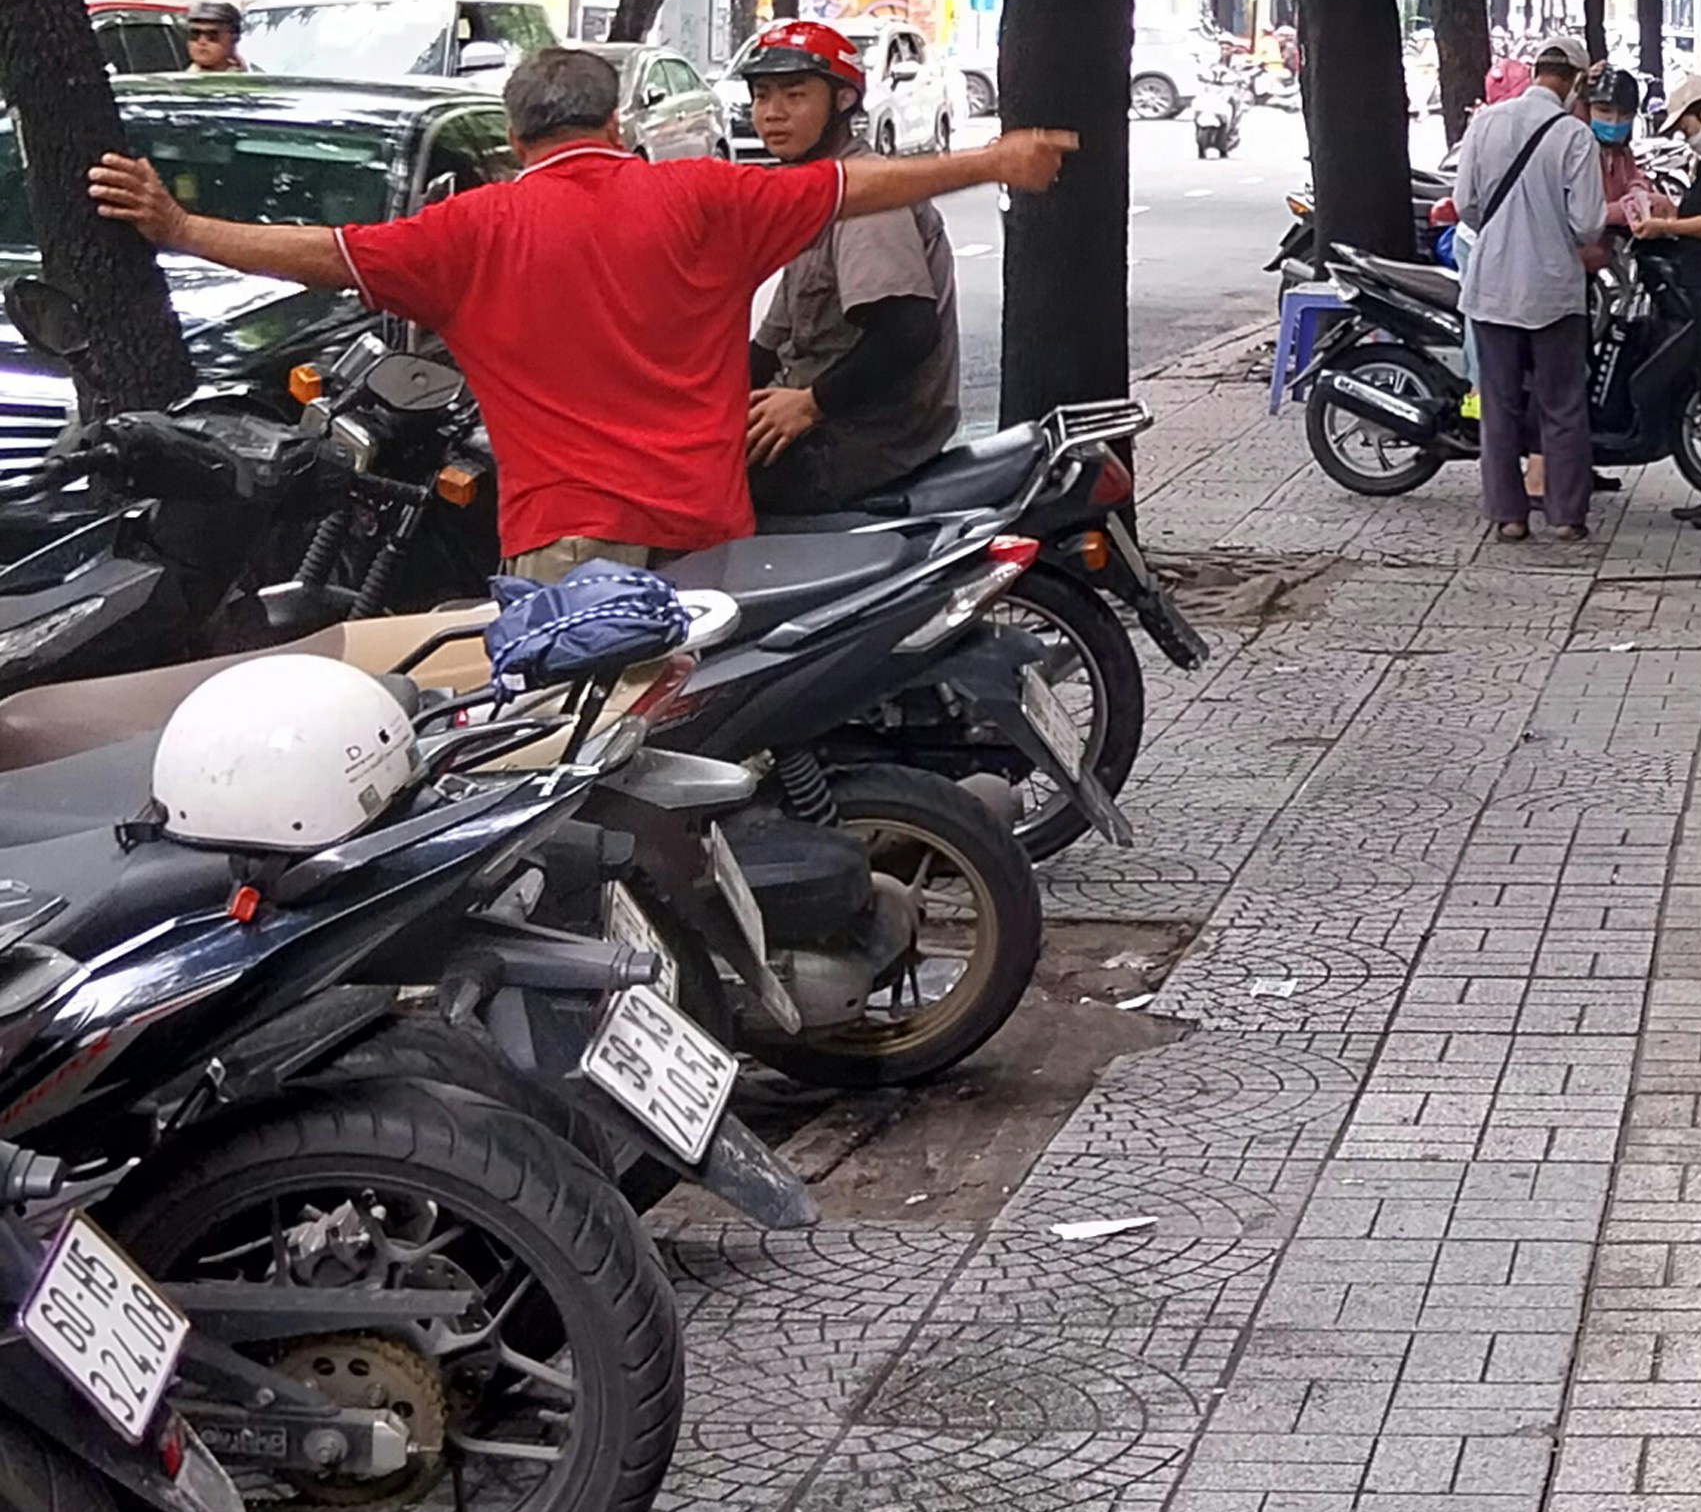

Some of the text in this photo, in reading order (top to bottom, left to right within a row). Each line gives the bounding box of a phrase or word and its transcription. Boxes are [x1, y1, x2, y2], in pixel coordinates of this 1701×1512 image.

[599, 993, 675, 1093] 59-X3
[647, 1032, 729, 1149] 740.54
[88, 1282, 177, 1423] 324.08
